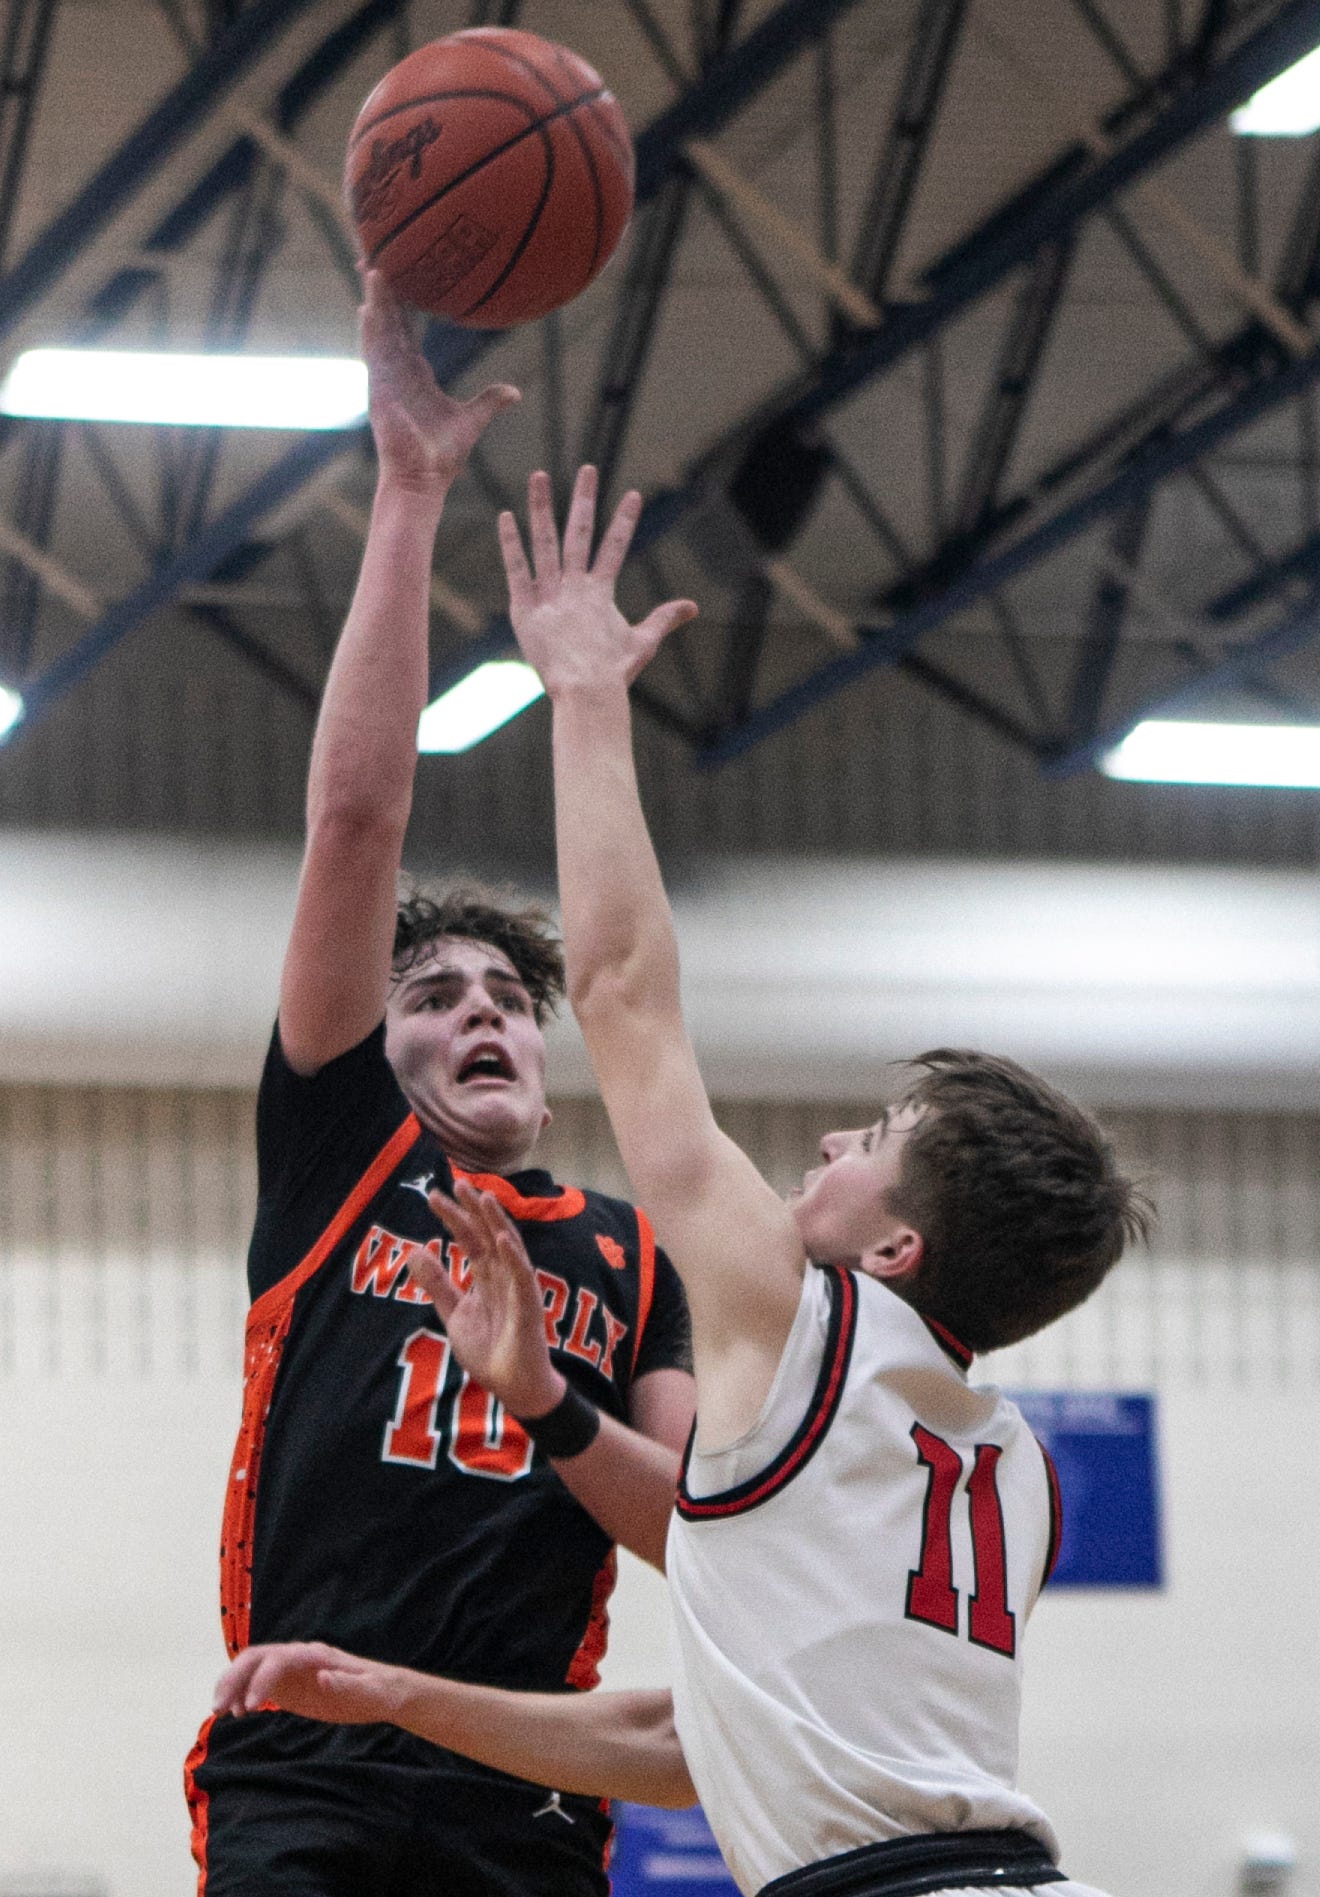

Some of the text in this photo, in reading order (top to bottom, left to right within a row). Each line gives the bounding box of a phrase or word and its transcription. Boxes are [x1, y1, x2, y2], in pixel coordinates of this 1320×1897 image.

[350, 1225, 628, 1381] WVRLY
[381, 1327, 535, 1482] 10
[904, 1420, 1016, 1660] 11
